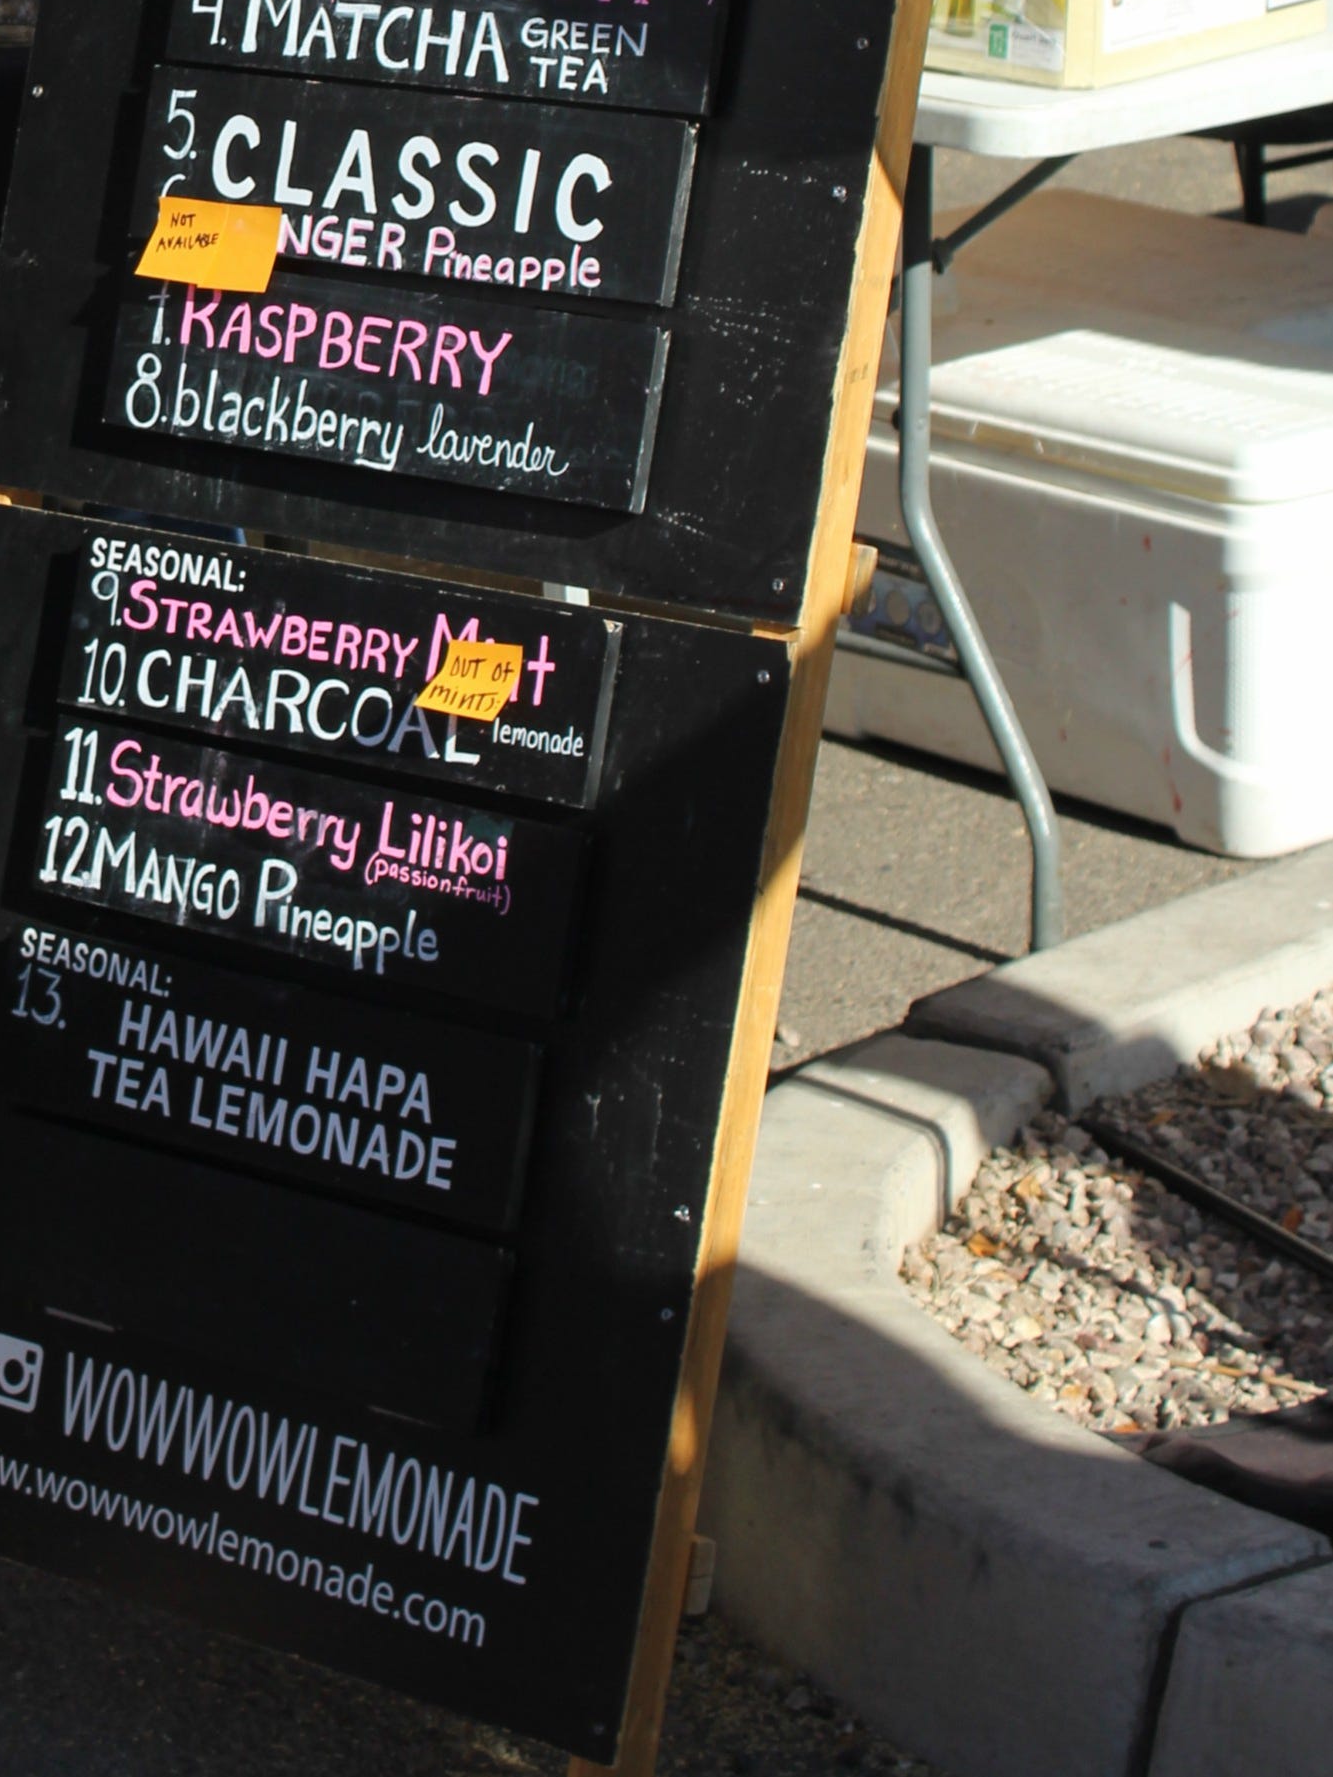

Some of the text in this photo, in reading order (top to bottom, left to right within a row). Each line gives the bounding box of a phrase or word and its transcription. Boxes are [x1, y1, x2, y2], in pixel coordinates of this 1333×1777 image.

[520, 16, 649, 58] GREEN
[529, 55, 610, 95] TEA
[162, 88, 614, 243] 5. CLASSIC
[155, 232, 220, 254] AVAILABLE
[170, 211, 197, 229] NOT
[277, 212, 604, 292] NGER Pineapple
[179, 282, 514, 397] RASPBERRY
[173, 362, 404, 472] blackberry
[417, 402, 569, 476] lavender
[89, 536, 246, 593] SEASONAL:
[122, 579, 420, 680] STRAWBERRY
[449, 655, 488, 680] OUT
[76, 636, 585, 766] 10. CHARCOAL lemonade
[105, 739, 362, 872] Strawberry
[377, 800, 509, 881] Lilikoi
[89, 826, 241, 921] MANGO
[254, 857, 440, 974] Pineapple
[19, 926, 173, 999] SEASONAL:
[117, 1000, 433, 1125] HAWAII HAPA
[87, 1048, 458, 1192] TEA LEMONADE
[62, 1351, 540, 1587] WOWWOWLEMONADE
